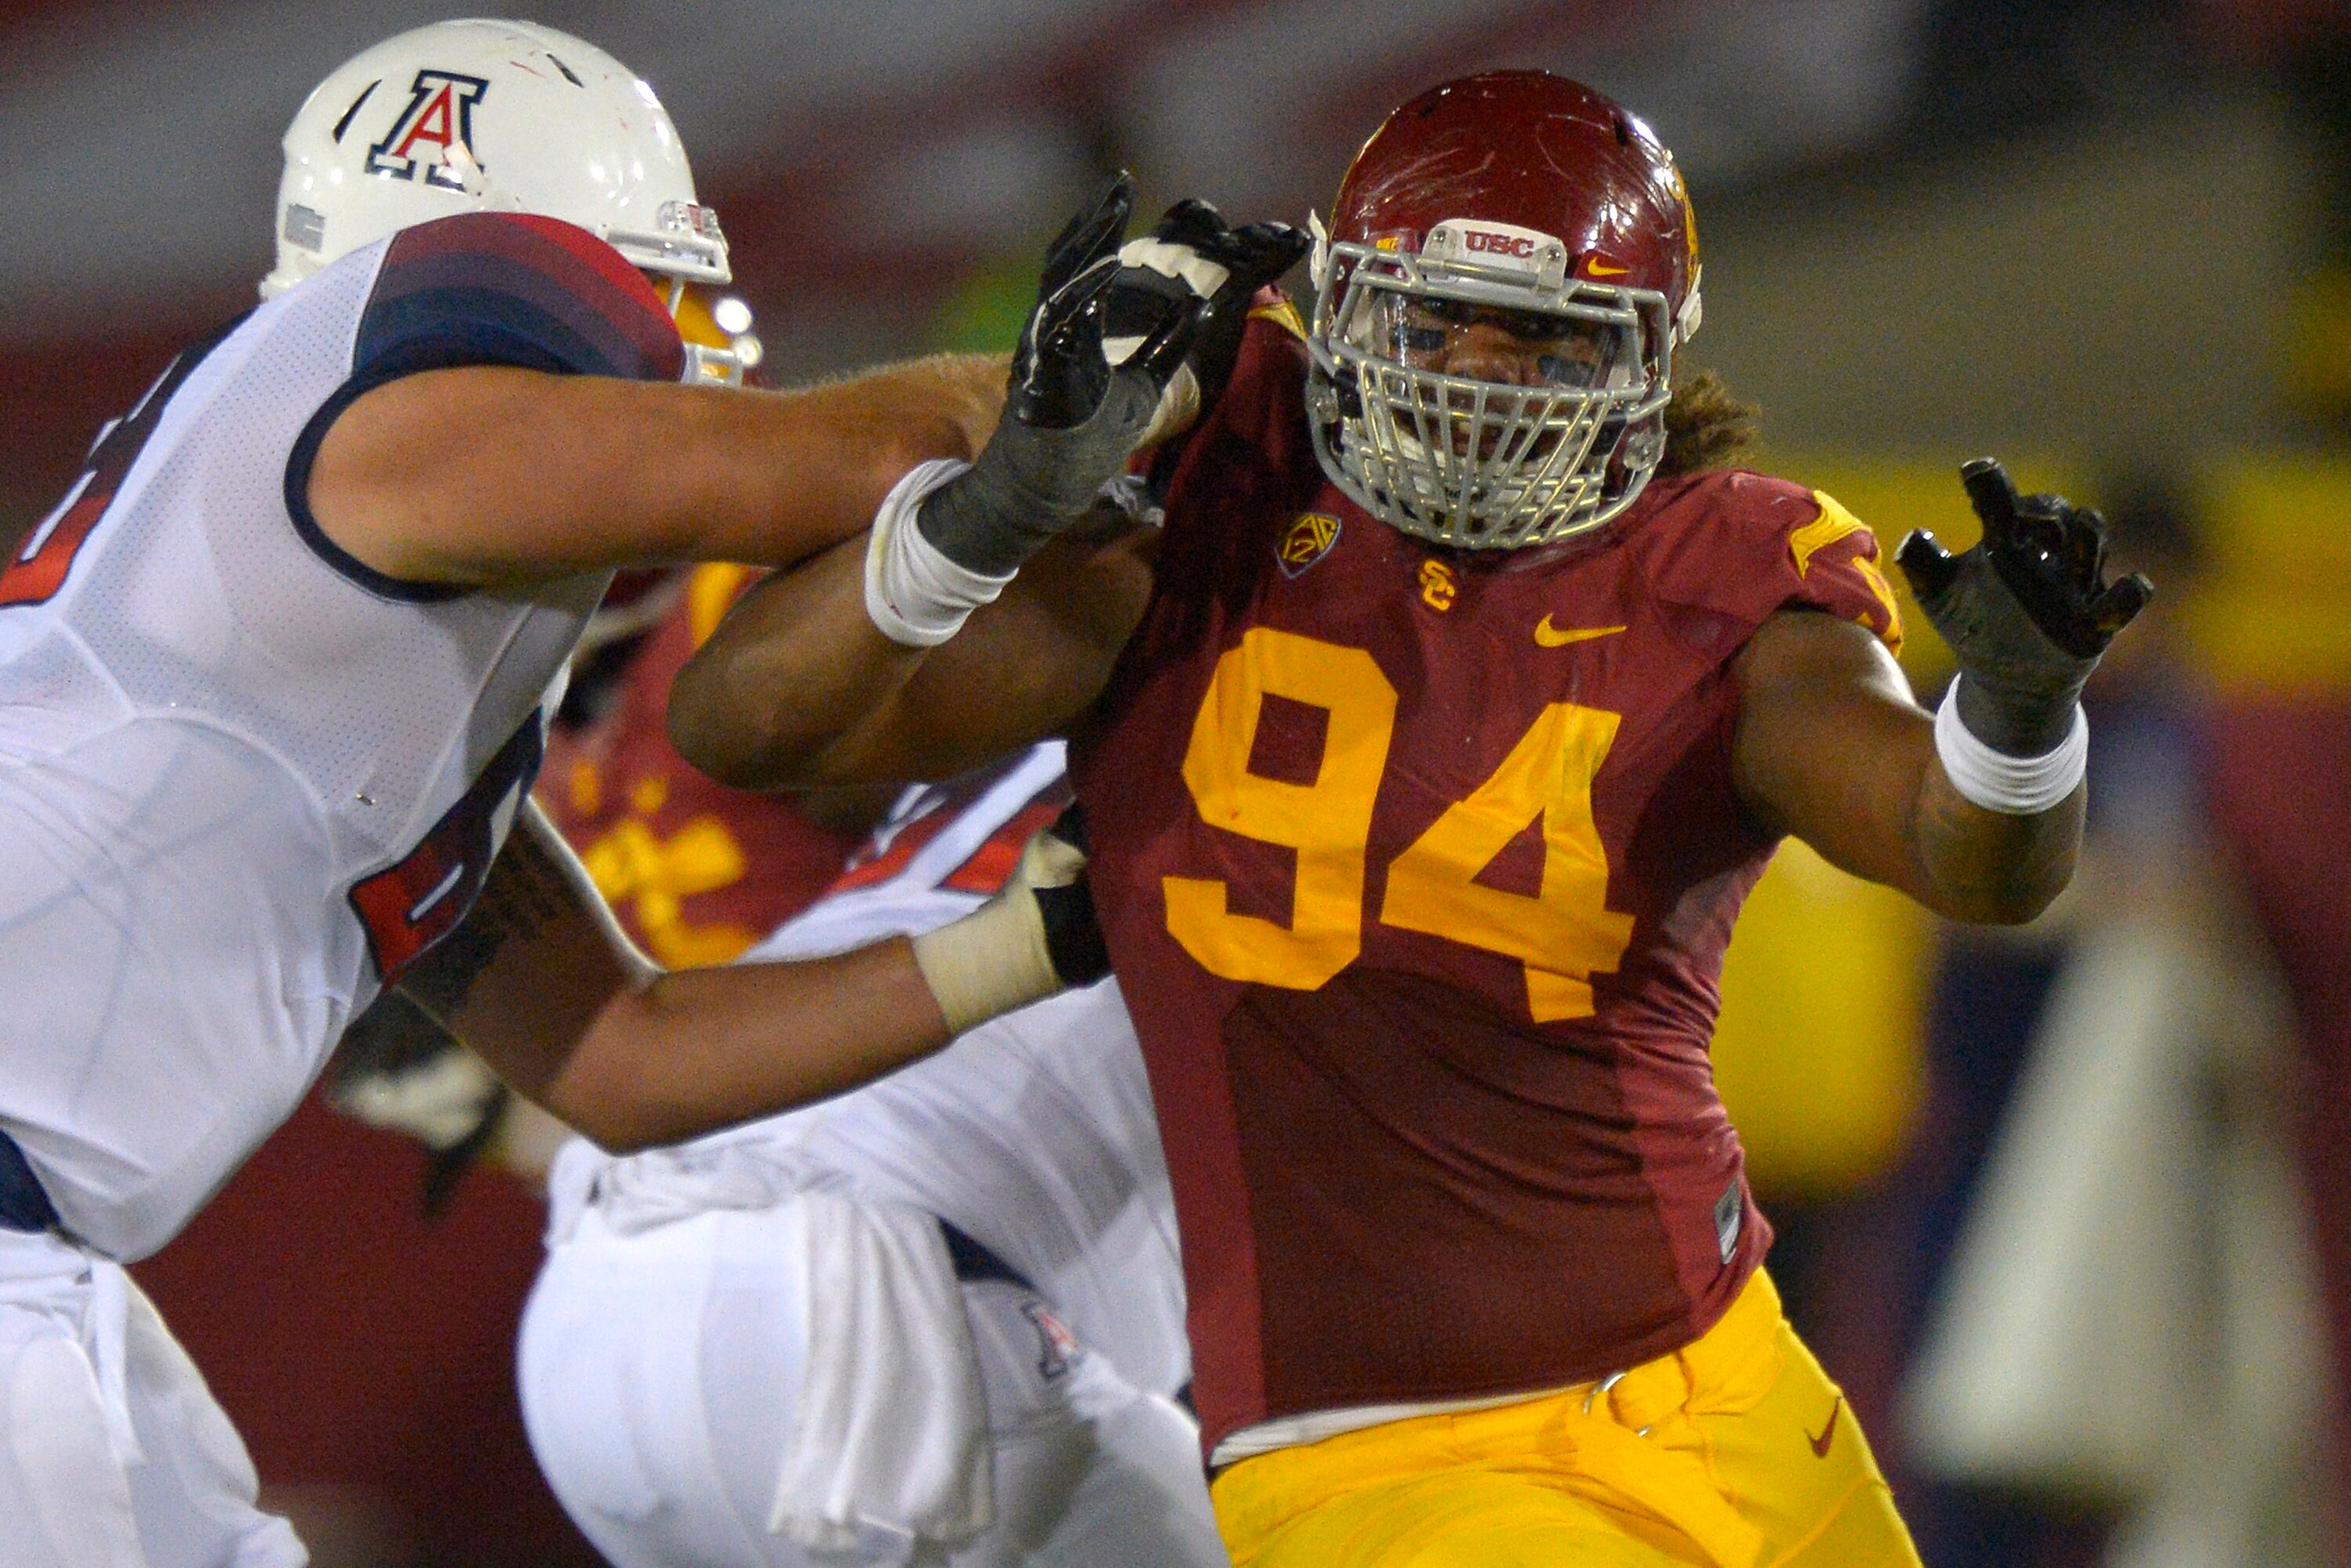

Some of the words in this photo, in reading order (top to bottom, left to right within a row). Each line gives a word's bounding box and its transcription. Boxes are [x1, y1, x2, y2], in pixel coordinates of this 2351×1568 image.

[365, 69, 490, 197] A
[1464, 230, 1534, 259] USC
[1162, 626, 1637, 1023] 94
